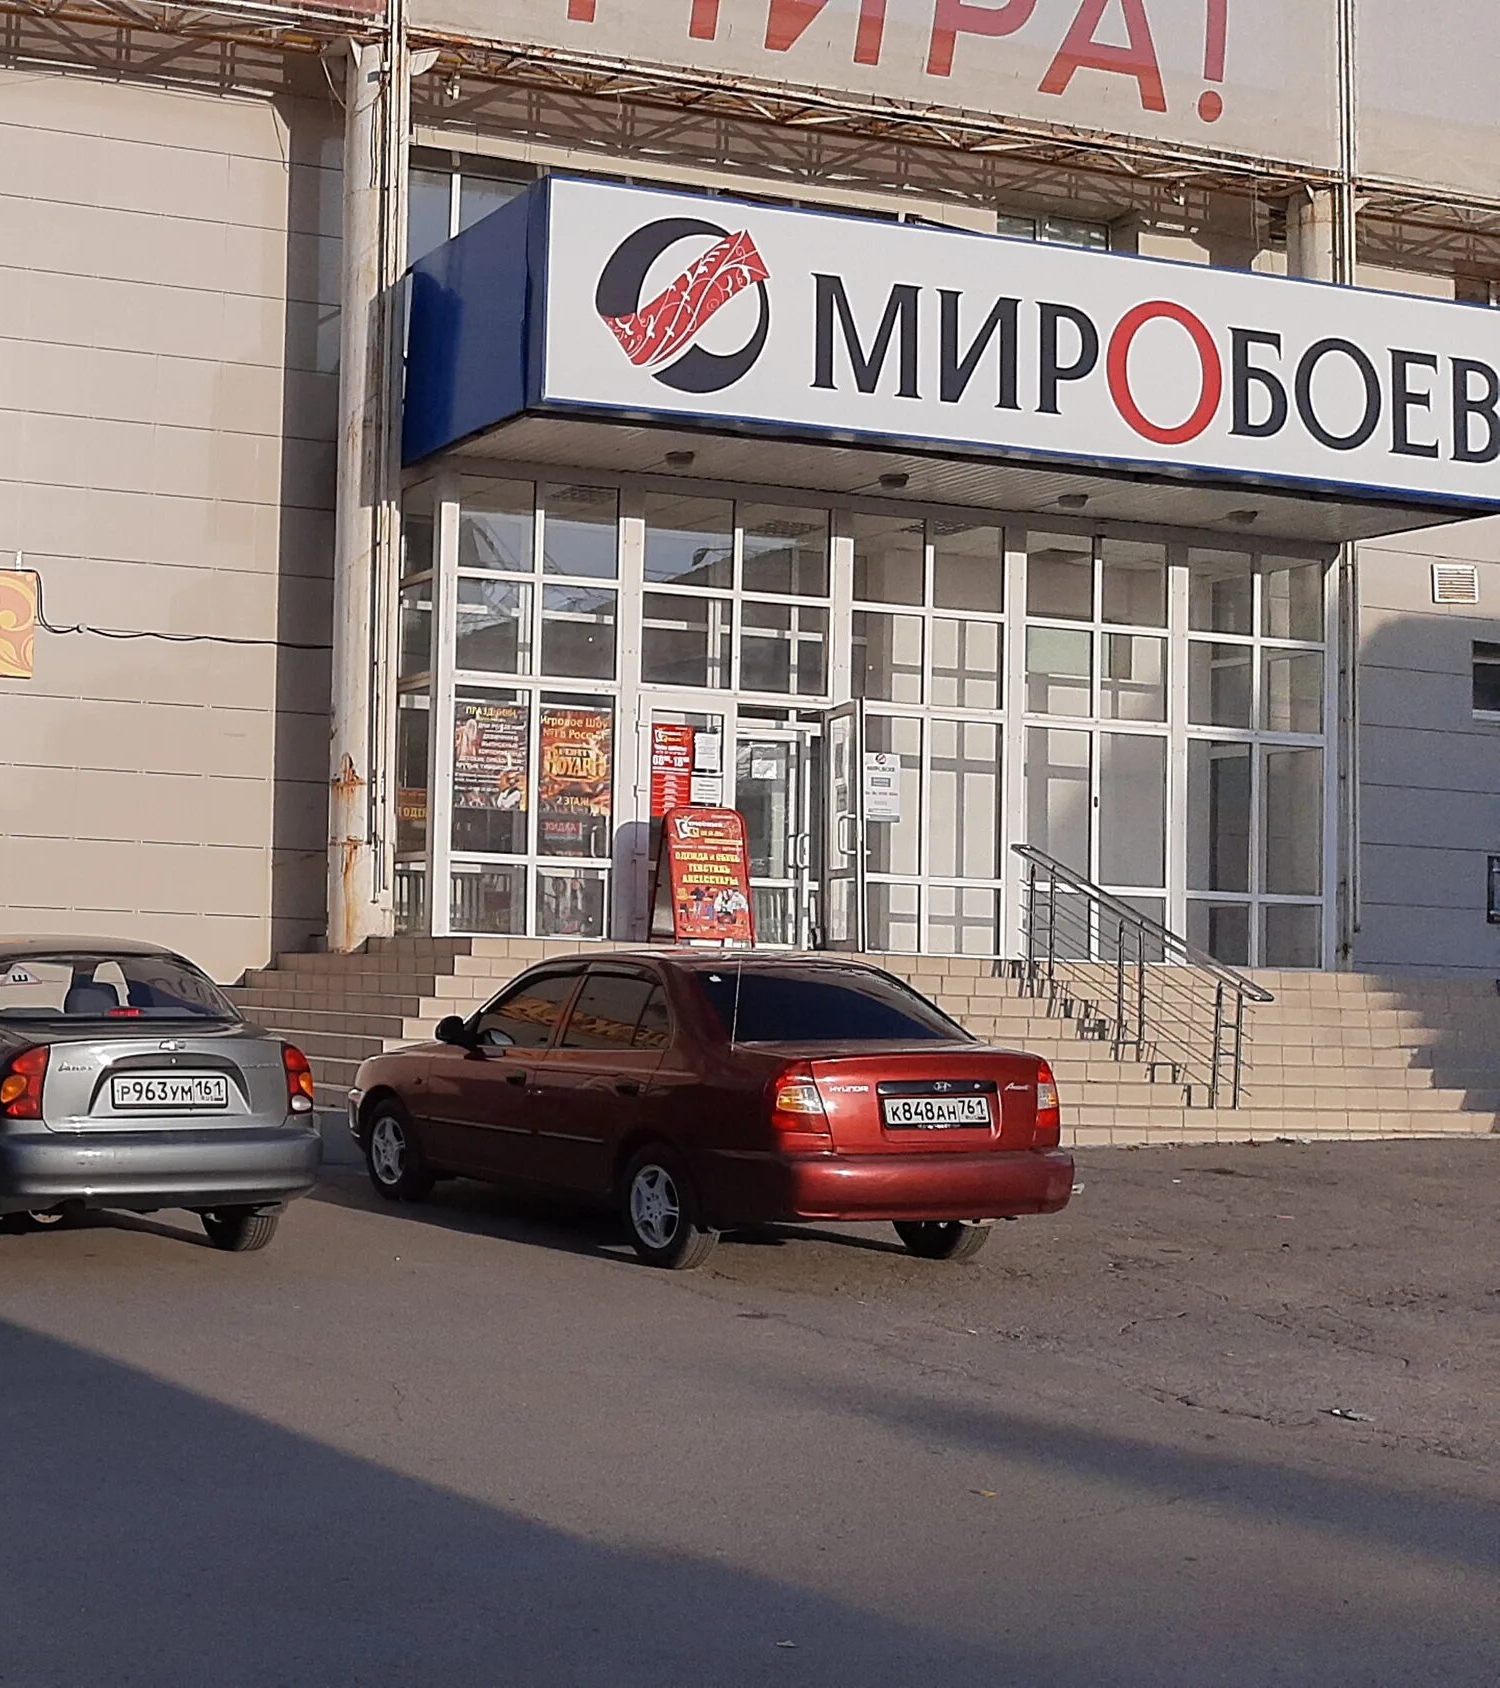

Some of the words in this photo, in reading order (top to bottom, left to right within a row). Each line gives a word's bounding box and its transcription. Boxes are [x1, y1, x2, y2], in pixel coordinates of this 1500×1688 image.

[810, 272, 1500, 466] МИРОБОЕВ
[11, 974, 29, 983] Ш
[120, 1081, 193, 1102] Р963УМ
[195, 1080, 223, 1097] 161
[891, 1101, 957, 1122] К848АН
[958, 1099, 985, 1115] 761
